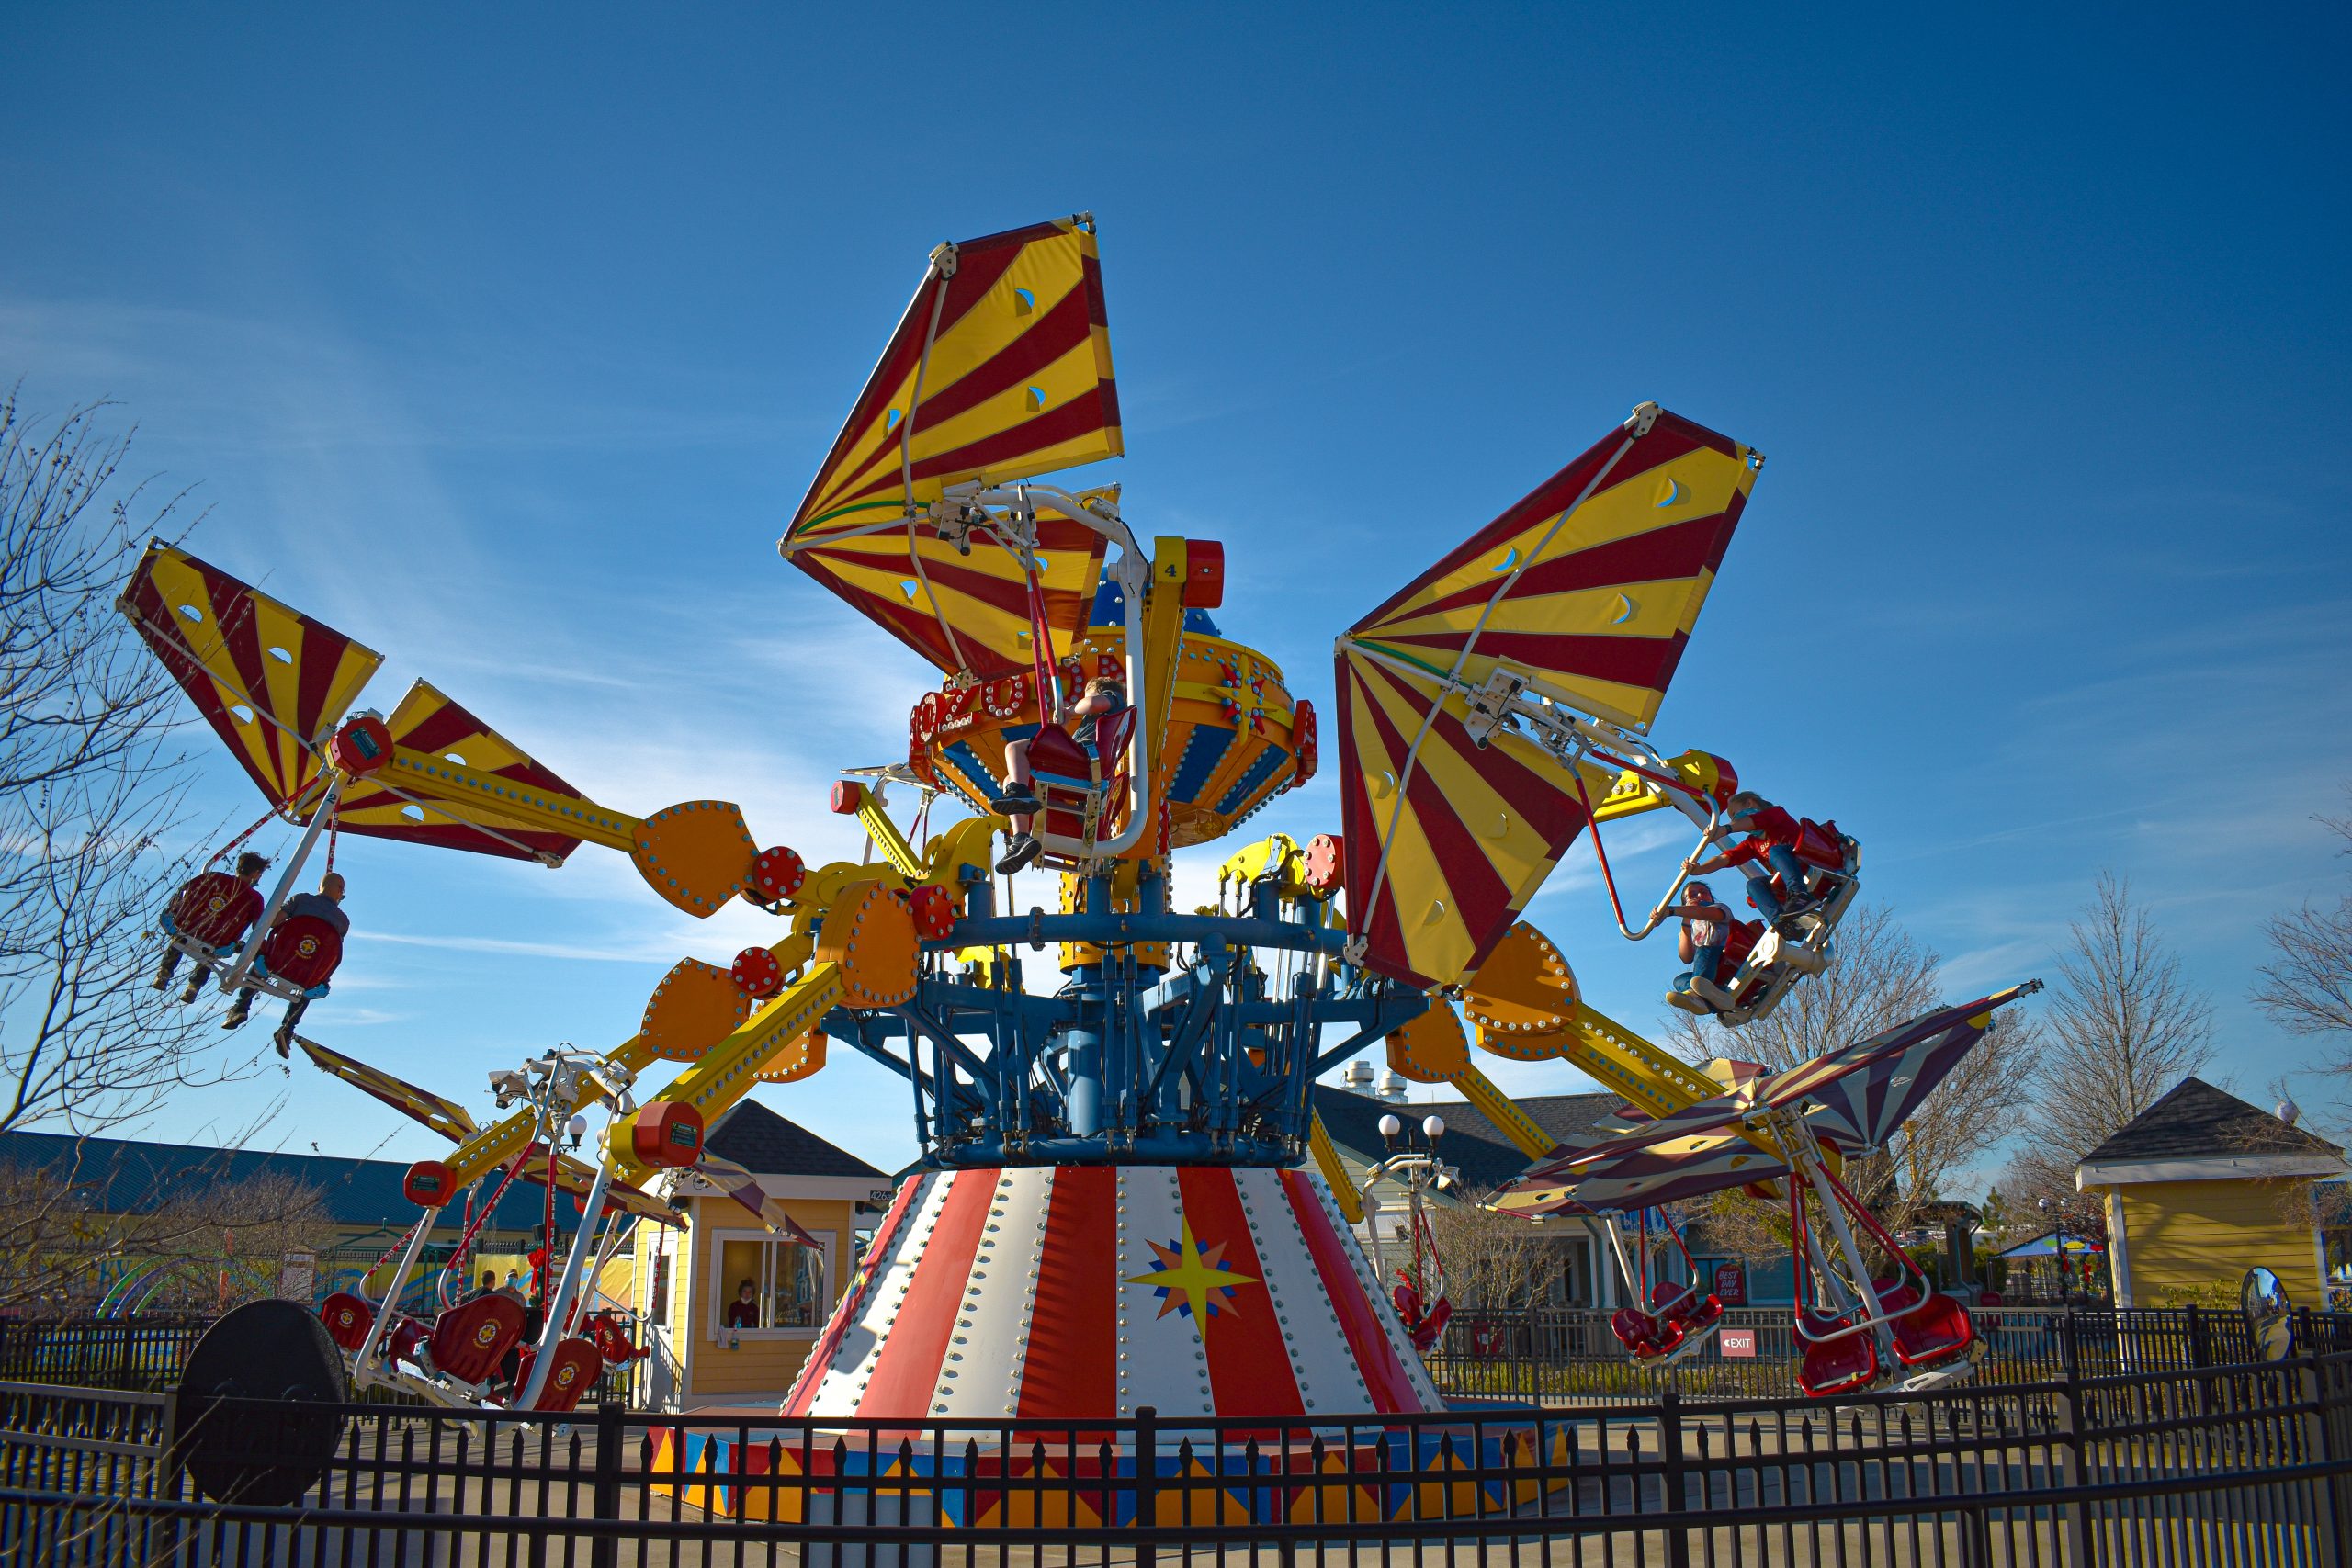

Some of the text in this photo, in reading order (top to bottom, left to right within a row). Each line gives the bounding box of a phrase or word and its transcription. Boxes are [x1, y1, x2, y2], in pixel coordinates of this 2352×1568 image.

[1165, 564, 1176, 578] 4
[326, 794, 336, 804] 2
[602, 1183, 610, 1195] 3
[1719, 1271, 1739, 1280] BEST
[1730, 1338, 1751, 1348] EXIT
